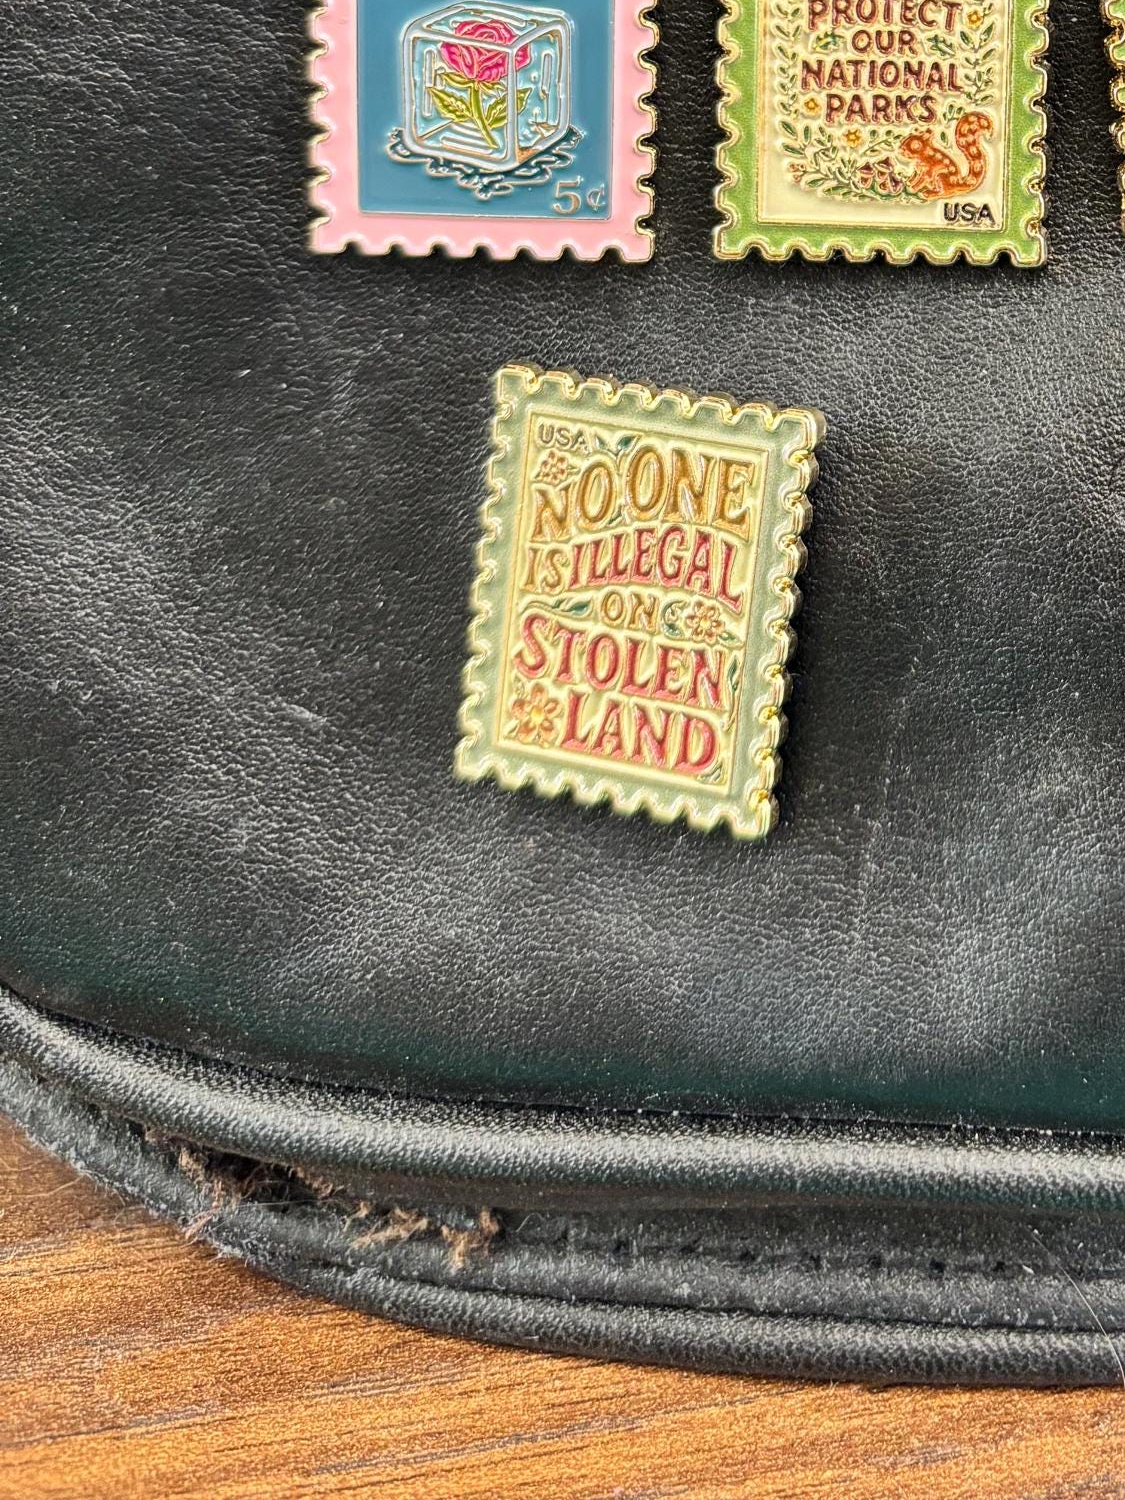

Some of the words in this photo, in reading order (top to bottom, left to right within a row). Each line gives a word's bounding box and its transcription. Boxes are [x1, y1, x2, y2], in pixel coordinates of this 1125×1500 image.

[851, 29, 917, 55] OUR
[800, 58, 963, 93] NATIONAL
[825, 93, 937, 125] PARKS
[553, 180, 606, 214] 5¢
[943, 202, 996, 227] USA
[538, 423, 591, 450] USA
[531, 459, 616, 541] NO
[625, 444, 755, 540] ONE
[524, 546, 569, 593] IS
[568, 525, 743, 615] ILLEGAL
[600, 589, 658, 632] ON
[513, 613, 725, 710] STOLEN
[561, 690, 720, 775] LAND
